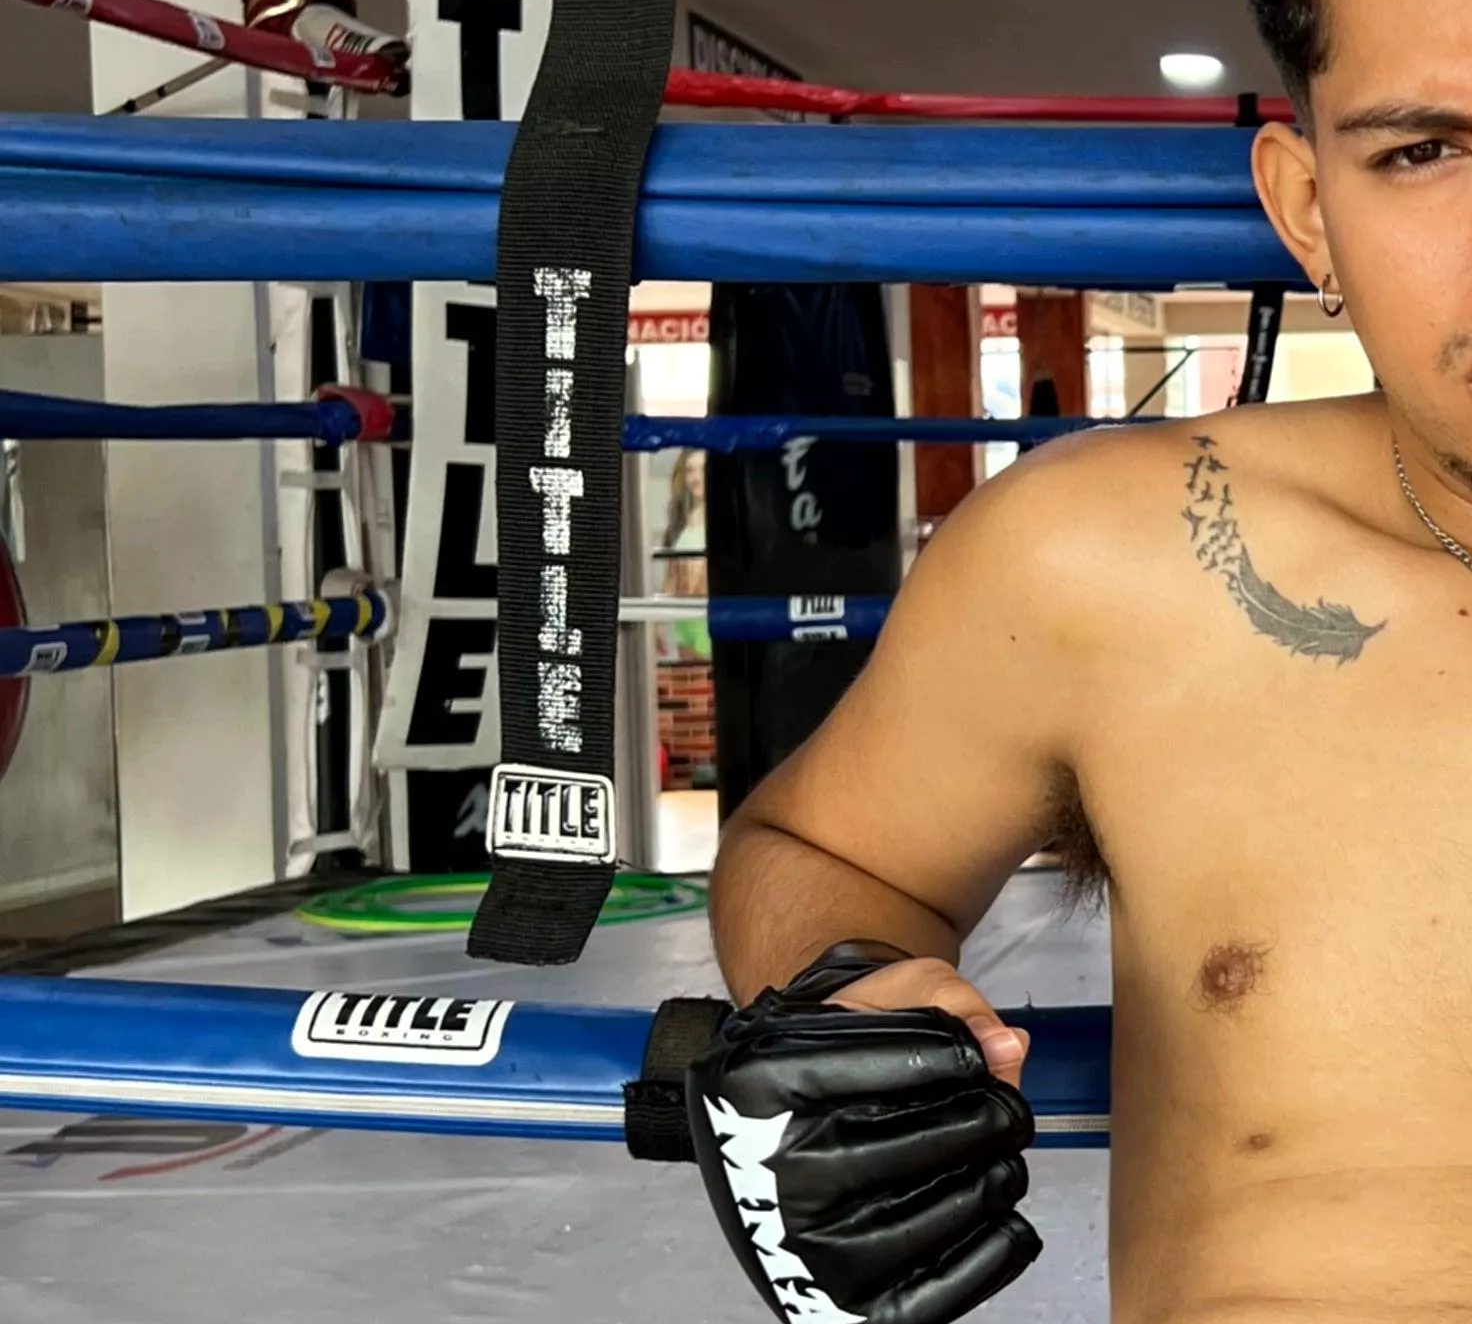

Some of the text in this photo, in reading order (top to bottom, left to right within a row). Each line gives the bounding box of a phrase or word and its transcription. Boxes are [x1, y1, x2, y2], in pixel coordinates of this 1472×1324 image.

[527, 266, 592, 754] TITLE
[503, 778, 601, 840] TITLE
[334, 992, 478, 1032] TITLE
[335, 1029, 453, 1042] BOXING
